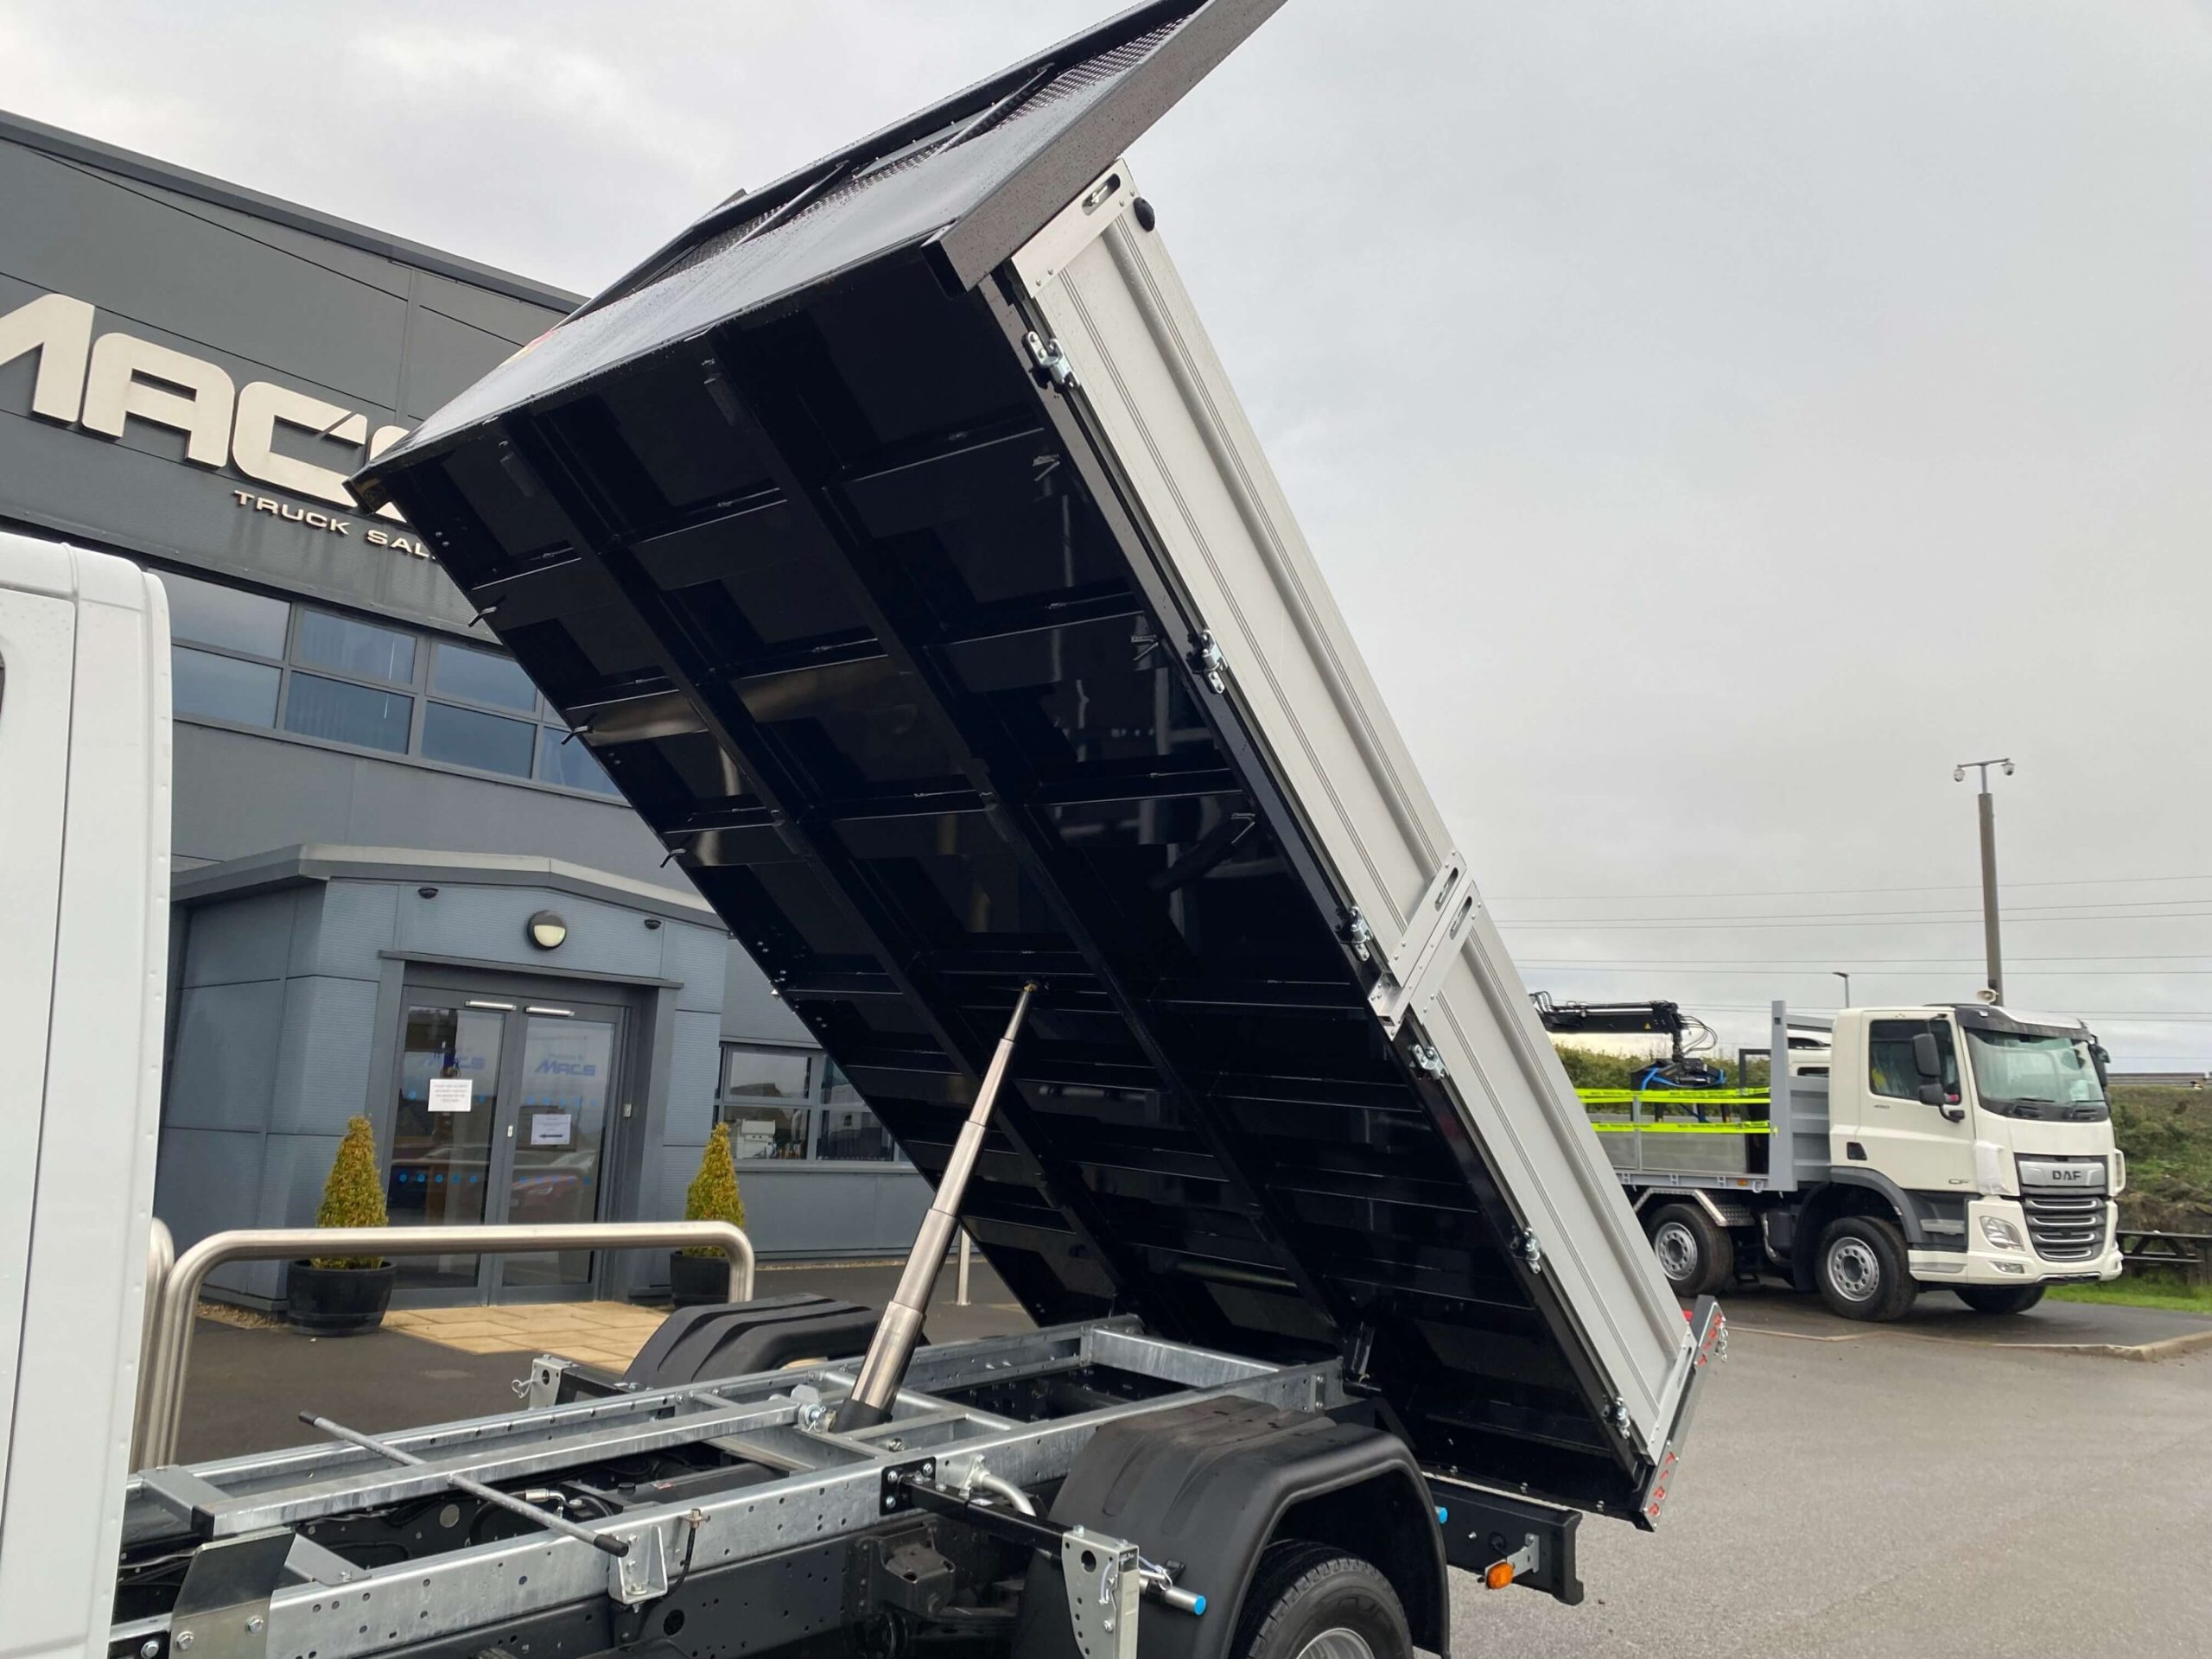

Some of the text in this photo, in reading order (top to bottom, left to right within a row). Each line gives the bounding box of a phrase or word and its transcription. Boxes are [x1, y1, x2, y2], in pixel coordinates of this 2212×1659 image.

[234, 490, 435, 560] TRUCK SAL
[534, 1058, 597, 1077] MACS
[2052, 1170, 2082, 1180] DAF
